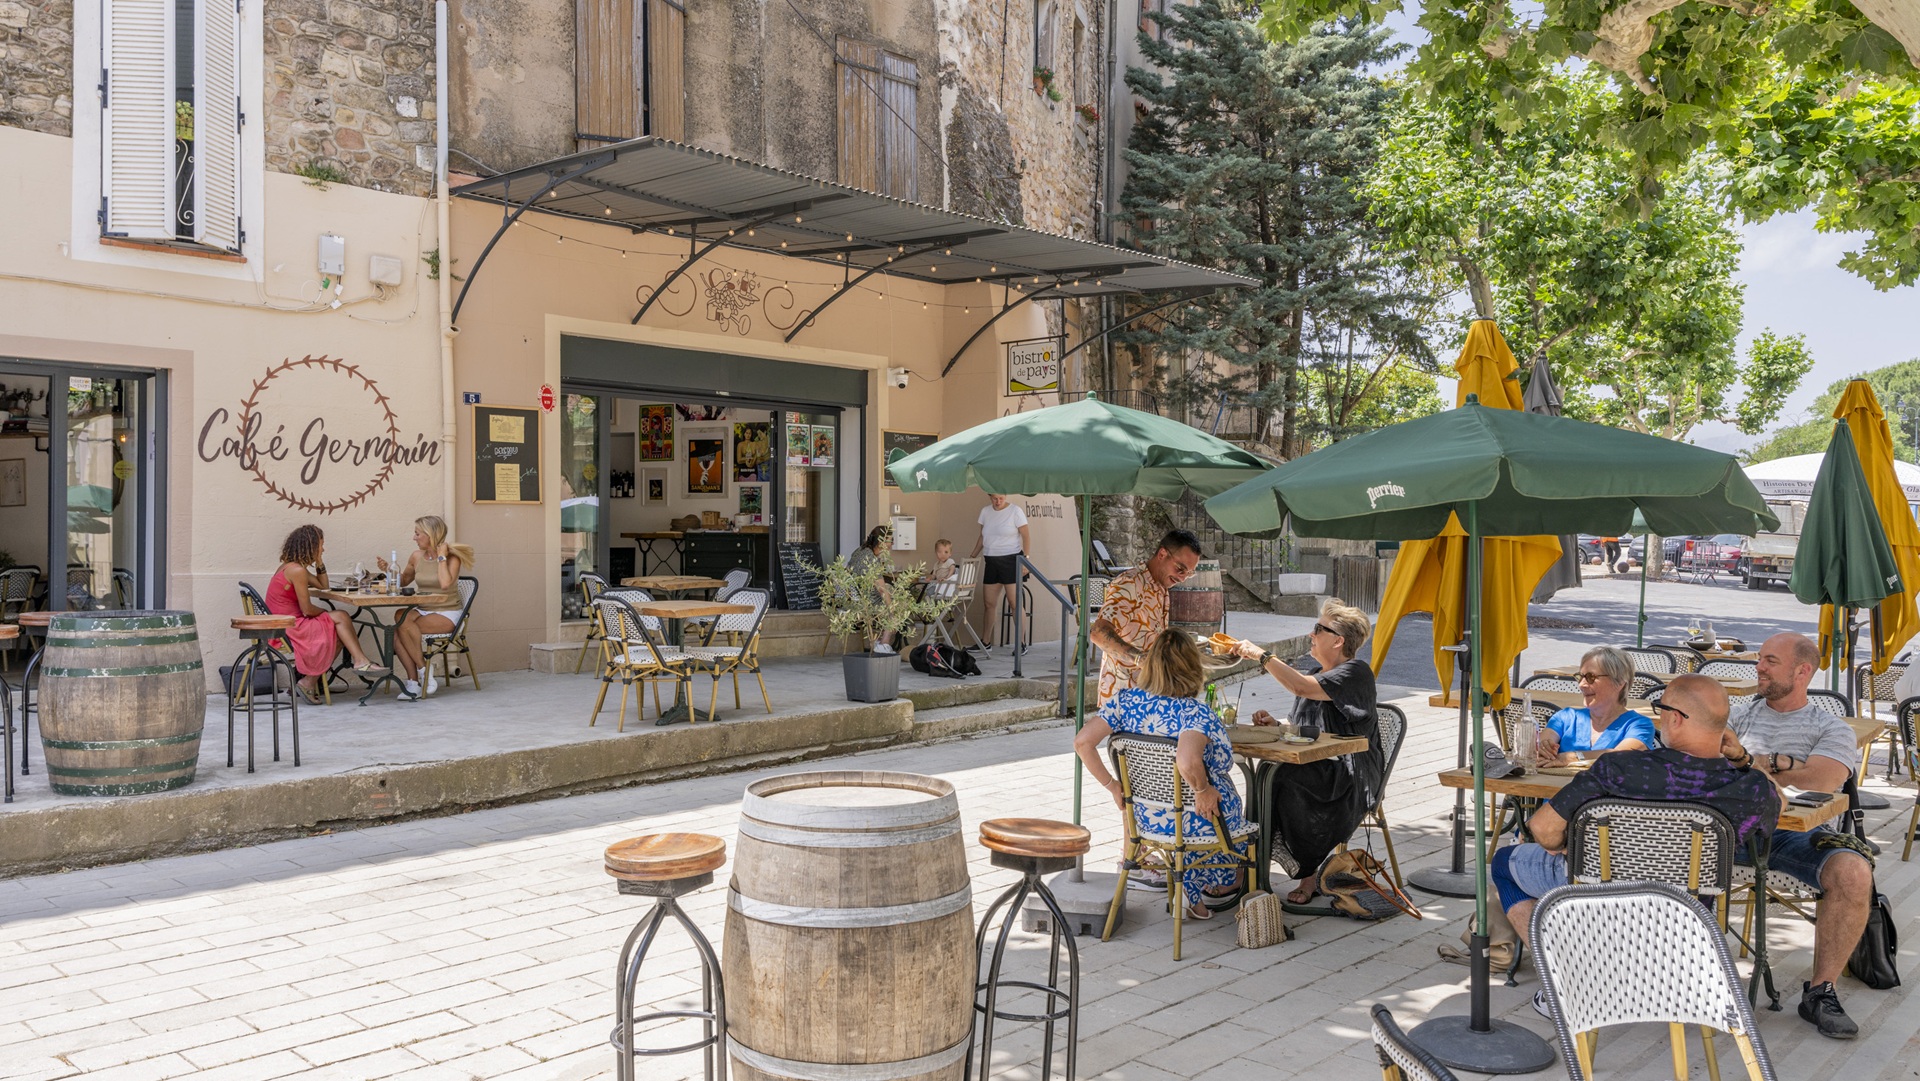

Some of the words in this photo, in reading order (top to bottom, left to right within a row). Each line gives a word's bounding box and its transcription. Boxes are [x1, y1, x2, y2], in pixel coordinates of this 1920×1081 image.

[1013, 350, 1056, 365] bistrot
[1017, 368, 1026, 376] de
[1027, 364, 1056, 380] pays
[469, 394, 476, 403] 5
[198, 407, 289, 471] Café
[300, 417, 441, 485] Germain
